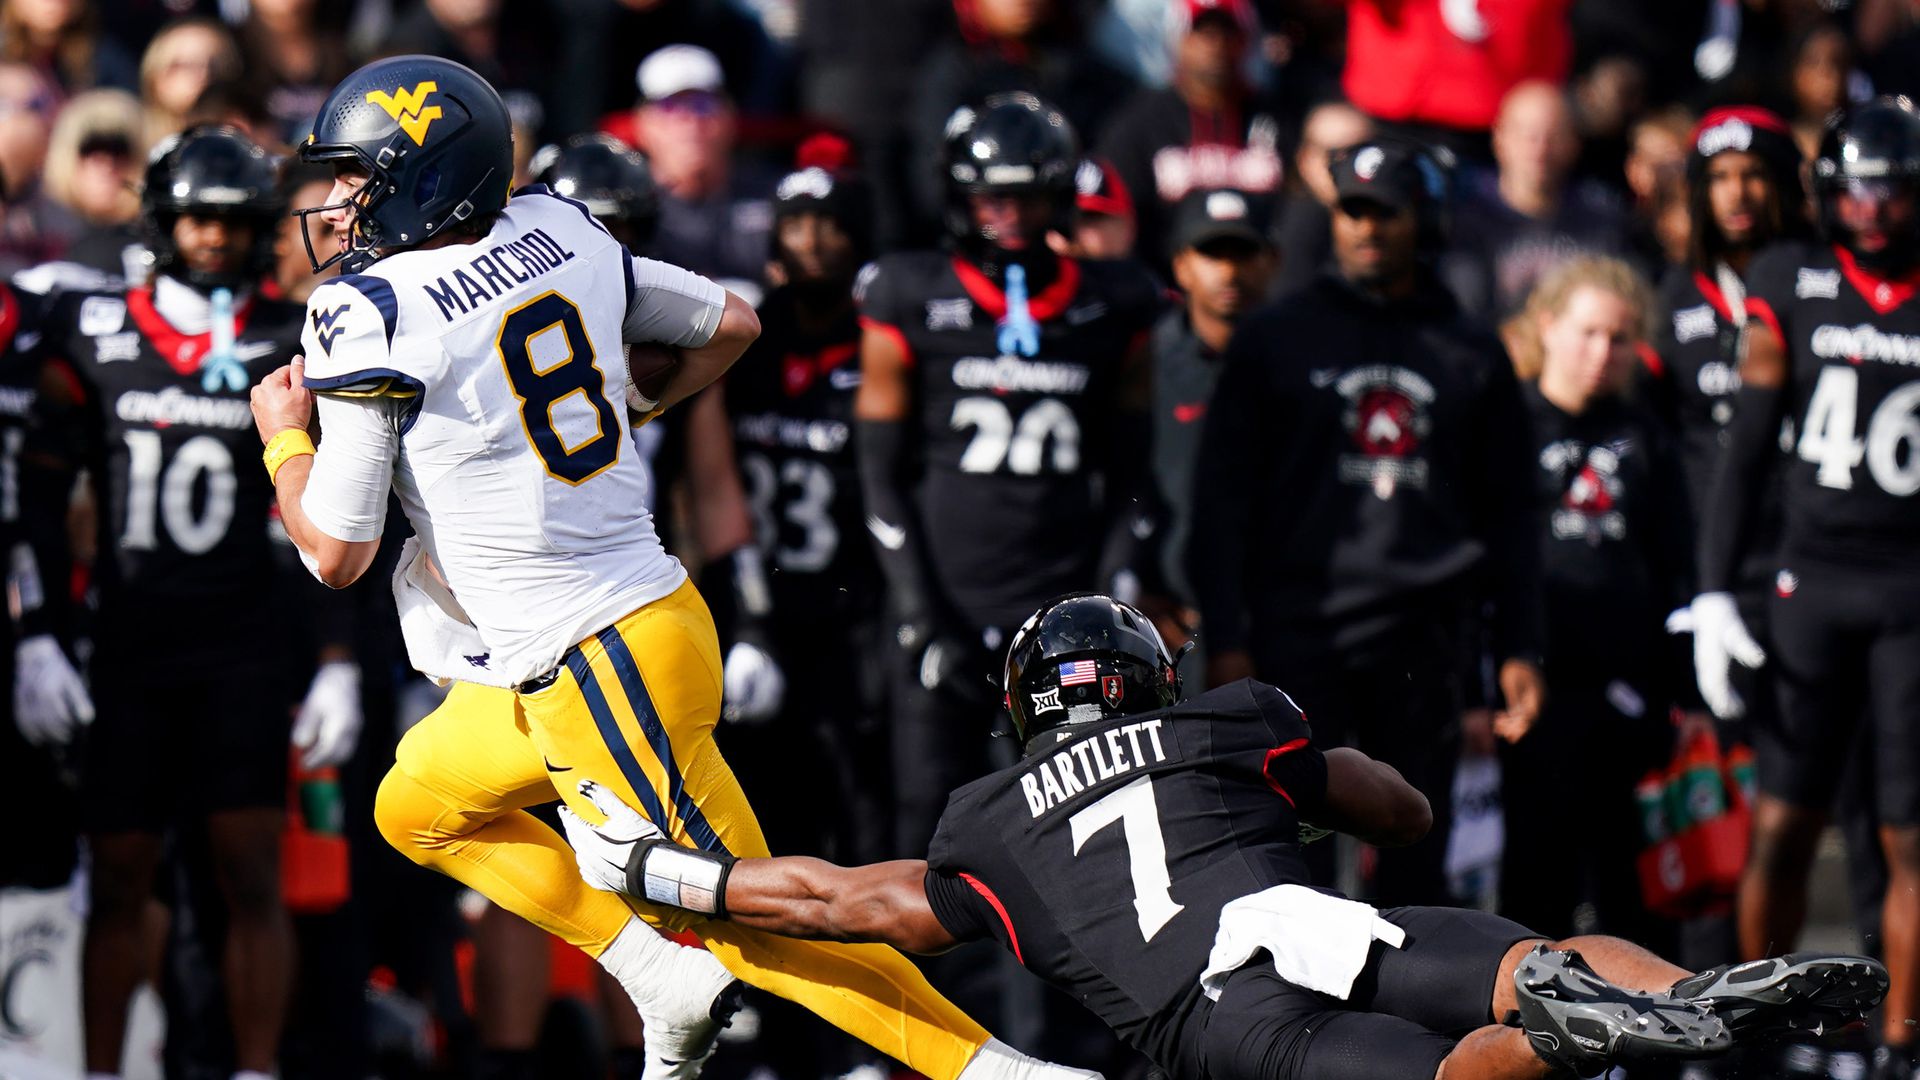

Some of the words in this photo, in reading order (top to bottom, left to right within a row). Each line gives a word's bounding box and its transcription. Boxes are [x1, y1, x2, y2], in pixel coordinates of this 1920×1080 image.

[494, 289, 622, 486] 8
[1798, 365, 1920, 496] 46
[120, 429, 239, 554] 10
[1020, 719, 1166, 818] BARTLETT
[1069, 774, 1185, 943] 7
